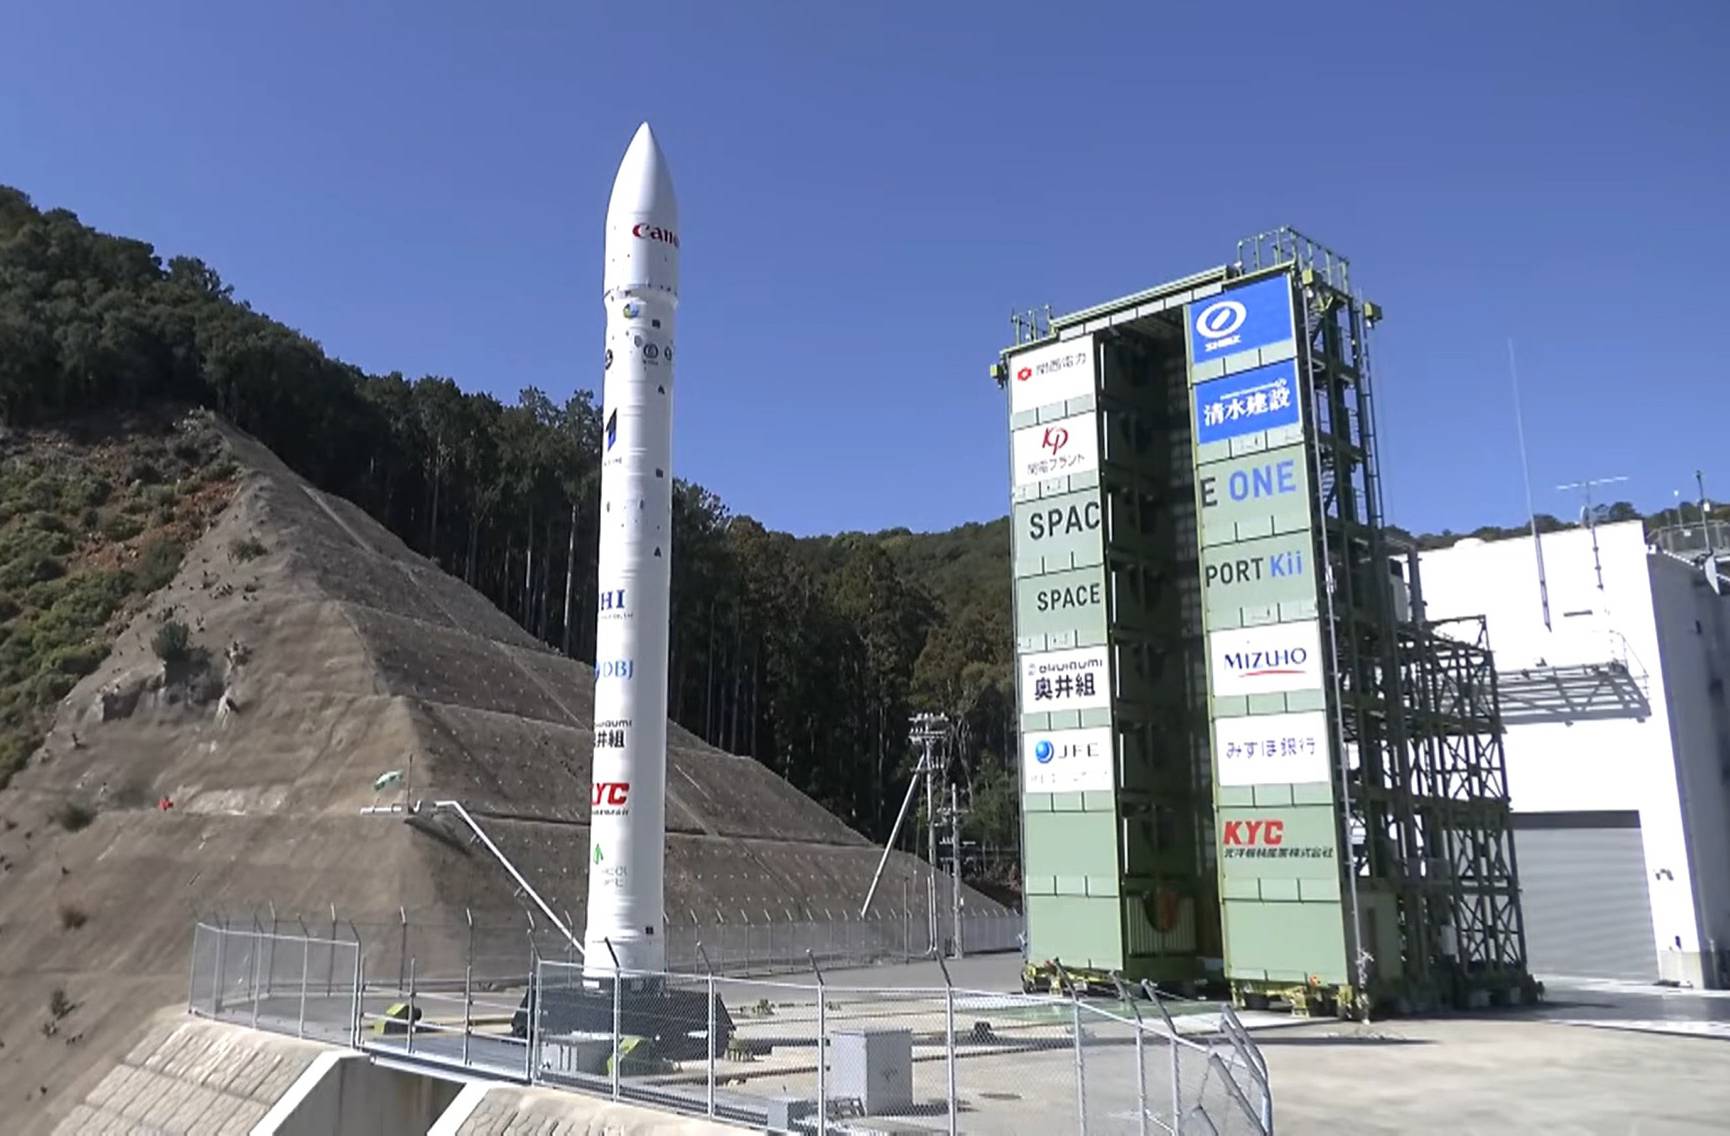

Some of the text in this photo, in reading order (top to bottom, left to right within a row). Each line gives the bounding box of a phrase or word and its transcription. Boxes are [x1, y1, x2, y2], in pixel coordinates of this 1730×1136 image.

[1203, 386, 1291, 427] 清水建設
[1200, 459, 1297, 508] E ONE
[1029, 501, 1101, 541] SPAC
[1205, 550, 1303, 589] PORT Kii
[1037, 582, 1101, 612] SPACE
[603, 659, 633, 681] DBJ
[1224, 646, 1308, 671] MIZUHO
[1034, 672, 1096, 701] 奥井組
[593, 729, 625, 748] 井組
[1058, 742, 1100, 759] JFE
[1223, 820, 1284, 845] KYC
